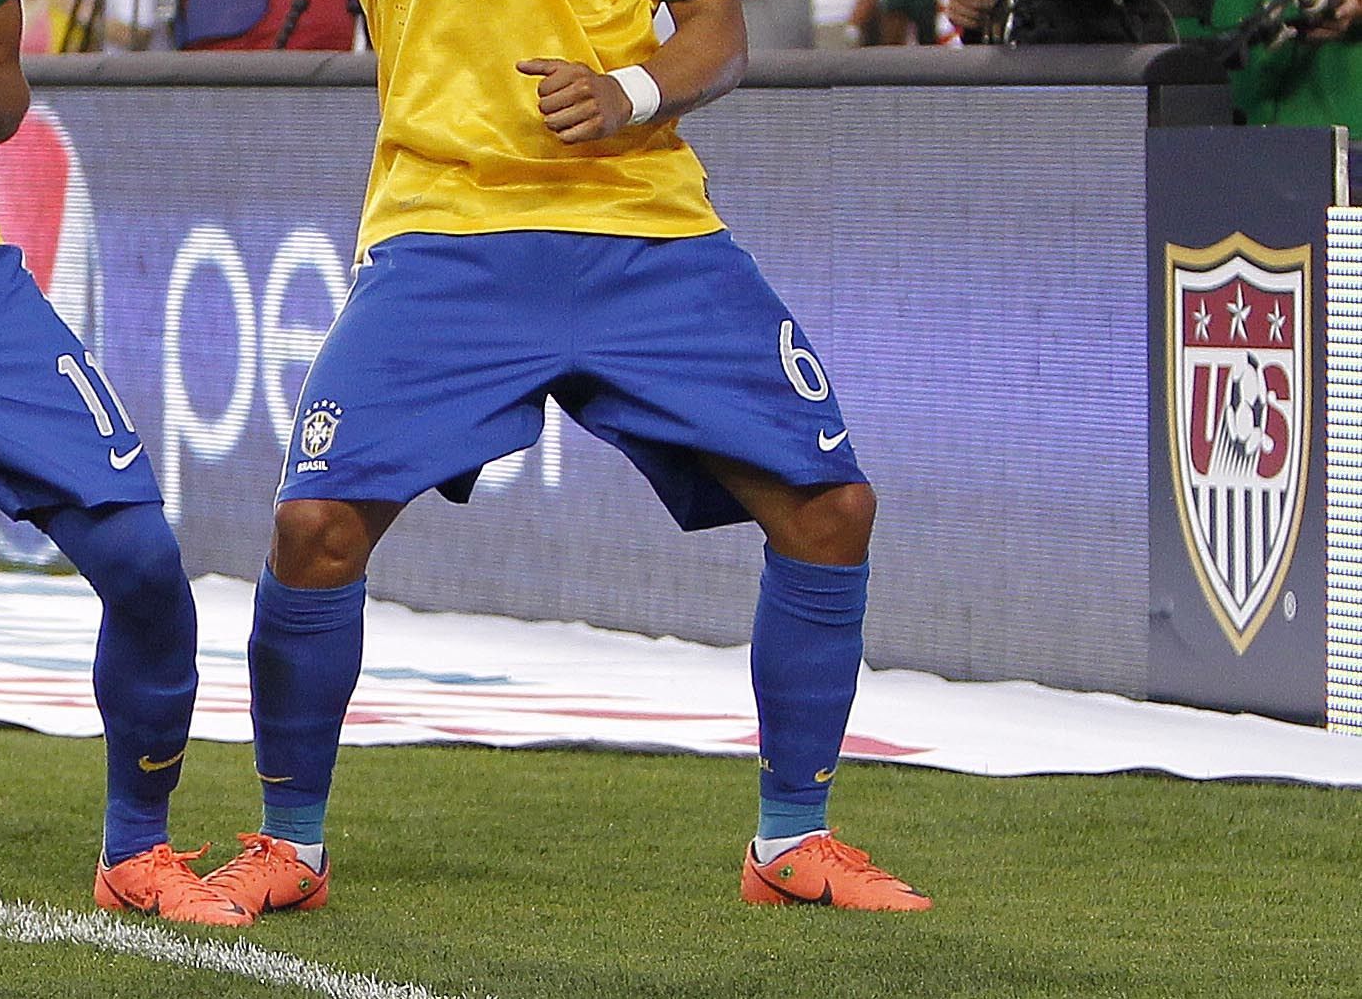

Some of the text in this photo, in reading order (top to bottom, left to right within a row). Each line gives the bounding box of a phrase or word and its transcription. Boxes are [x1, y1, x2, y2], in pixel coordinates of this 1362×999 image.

[57, 351, 135, 437] 11
[779, 319, 829, 402] 6
[1191, 365, 1290, 478] US
[297, 460, 329, 474] BRASIL
